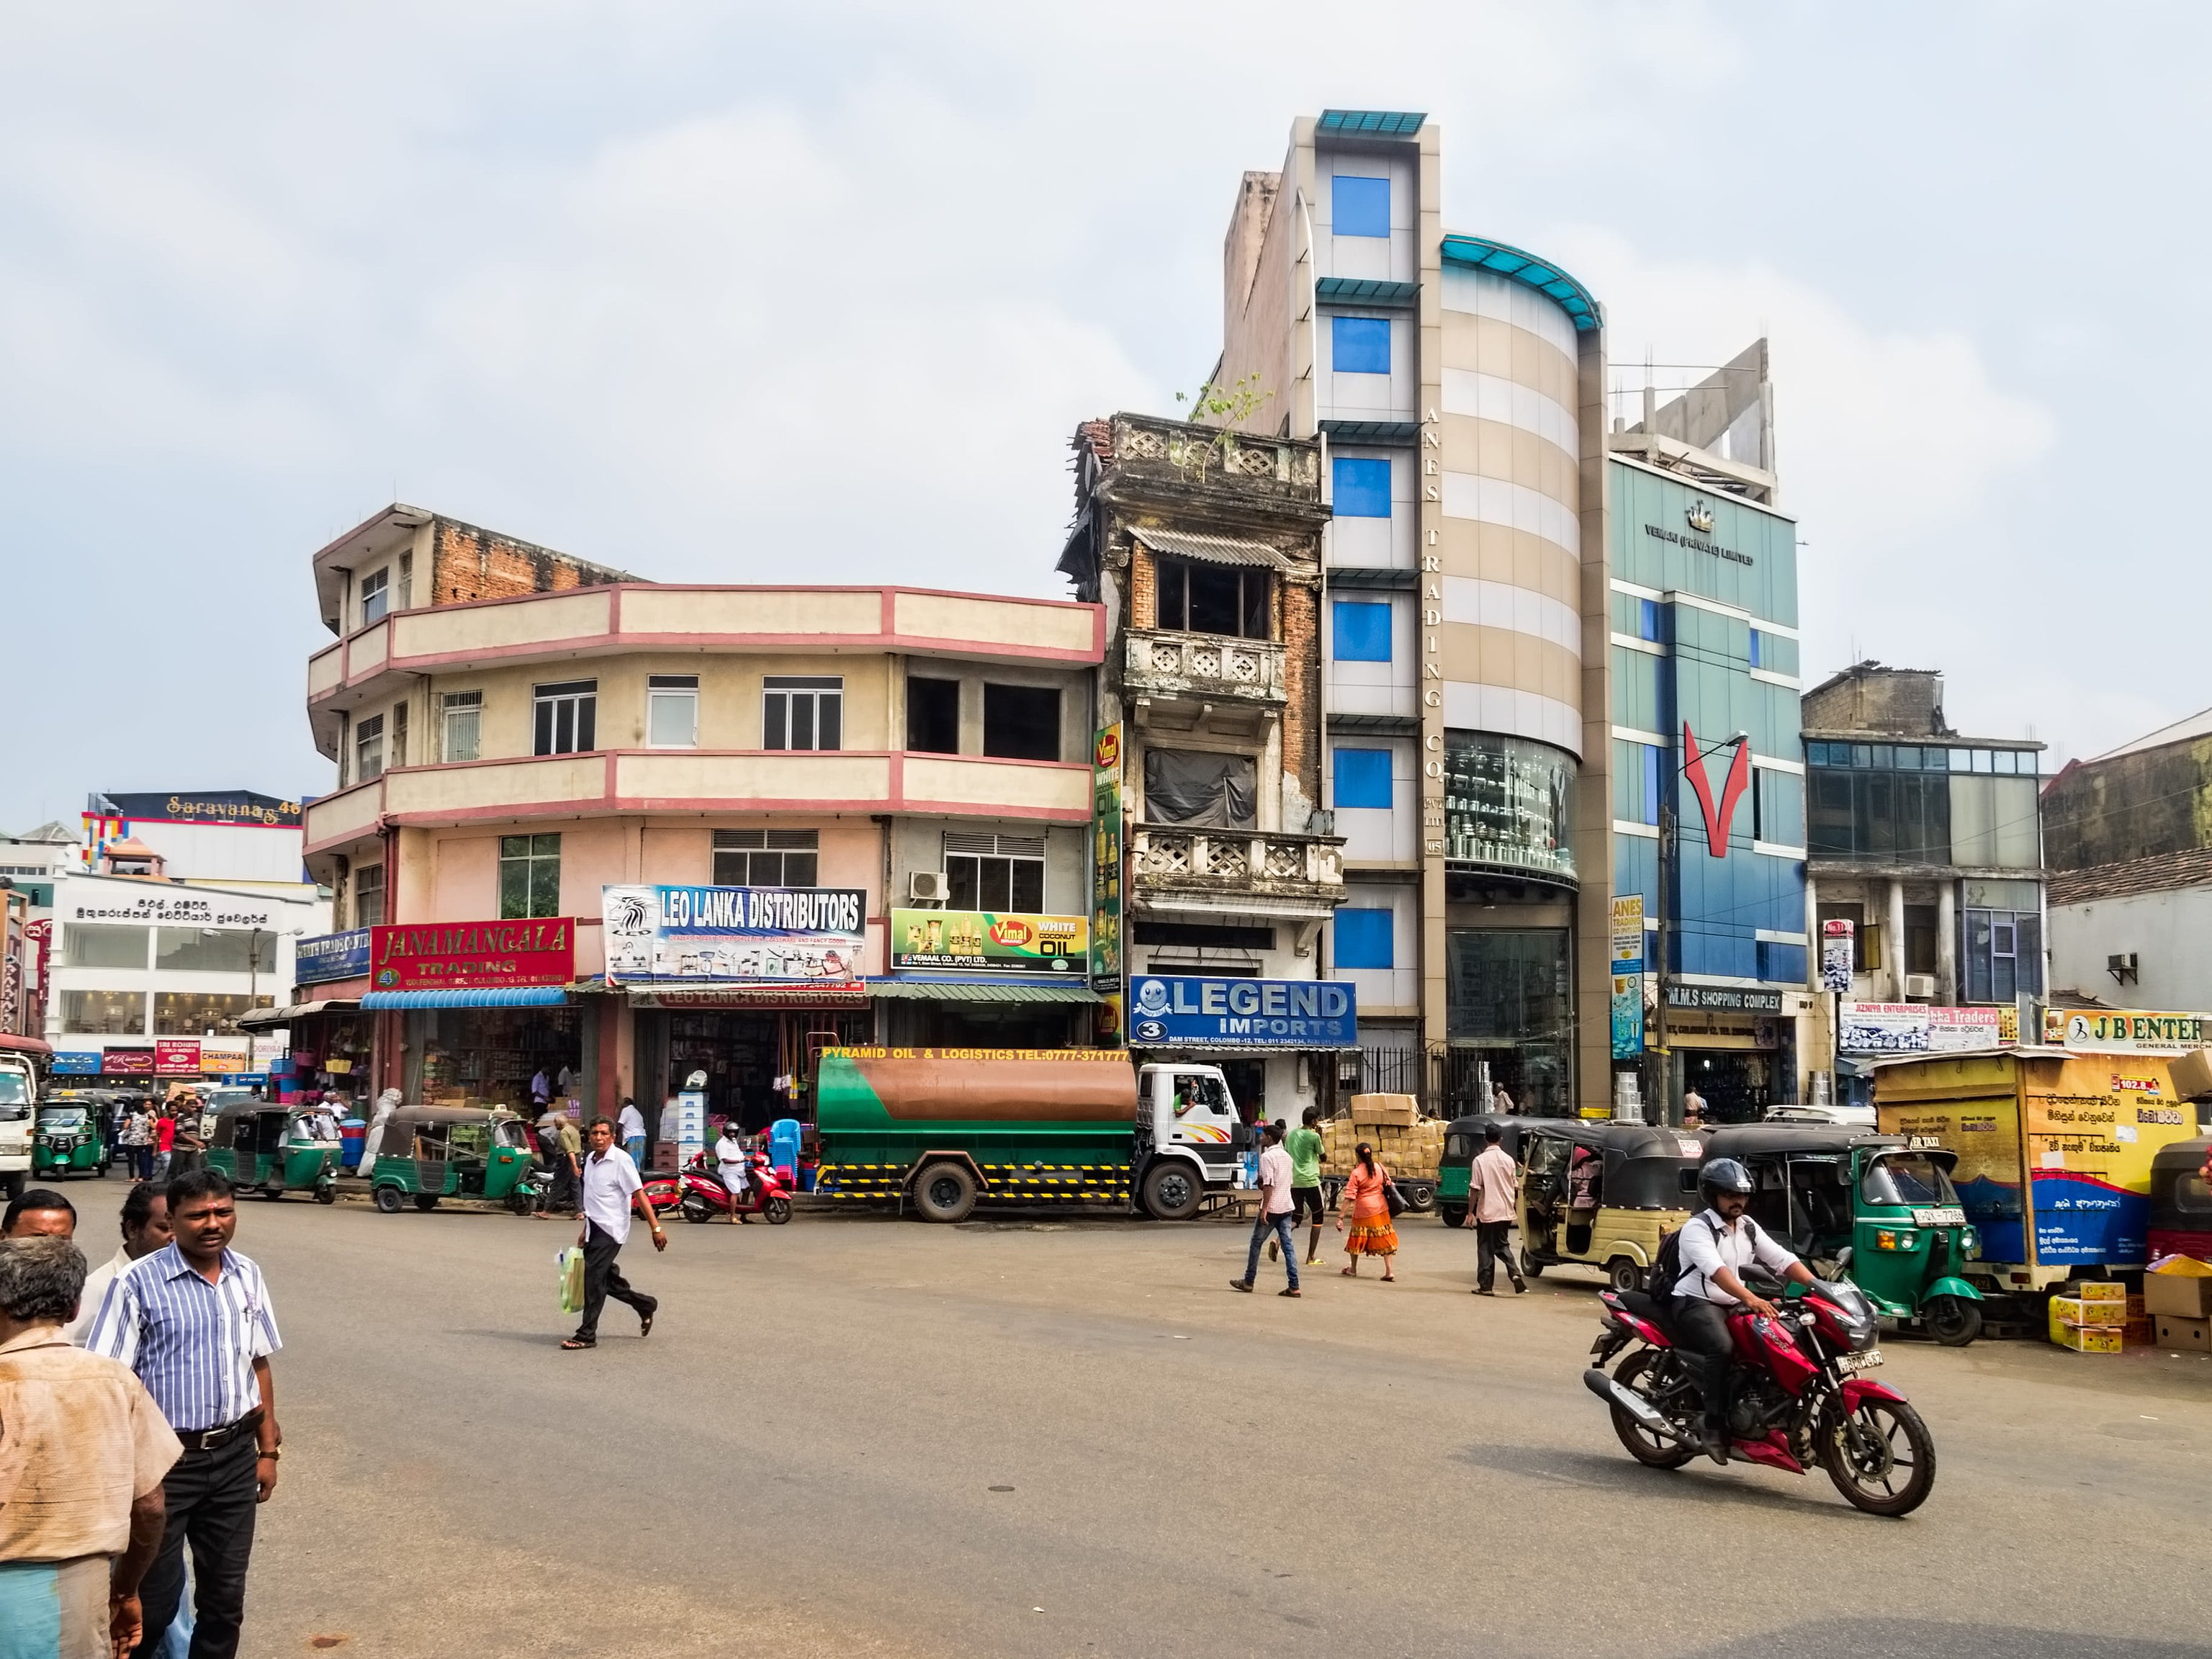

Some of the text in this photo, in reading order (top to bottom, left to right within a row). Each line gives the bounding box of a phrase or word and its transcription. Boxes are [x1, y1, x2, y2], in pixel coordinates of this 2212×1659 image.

[1424, 407, 1439, 501] ANES
[1721, 548, 1753, 566] LIMITED
[1424, 529, 1439, 708] TRADING
[1098, 737, 1116, 760] Vimal
[1096, 767, 1120, 786] WHITE
[166, 796, 276, 825] Saravanas
[1097, 791, 1118, 817] OIL
[661, 890, 859, 931] LEO LANKA DISTRIBUTORS
[1613, 899, 1641, 917] ANES
[994, 921, 1028, 940] Vimal
[1038, 922, 1076, 932] WHITE
[1613, 917, 1641, 927] TRADING
[379, 925, 566, 965] JANAMANGALA
[1040, 940, 1075, 957] OIL
[417, 960, 516, 975] TRADING
[379, 971, 393, 985] 4
[665, 992, 695, 1004] LEO
[699, 993, 751, 1004] LANKA
[1173, 981, 1348, 1017] LEGEND
[1668, 987, 1780, 1010] M.M.S SHOPPING COMPLEX
[1883, 1004, 1926, 1014] ENTERPRISES
[1953, 1010, 1996, 1023] Traders
[1142, 1022, 1160, 1037] 3
[1220, 1017, 1342, 1036] IMPORTS
[2095, 1017, 2106, 1040] J
[2113, 1017, 2127, 1040] B
[822, 1048, 886, 1058] PYRAMID
[893, 1048, 917, 1058] OIL
[923, 1048, 934, 1058] &
[942, 1048, 1014, 1061] LOGISTICS
[1923, 1137, 1939, 1147] TAXI
